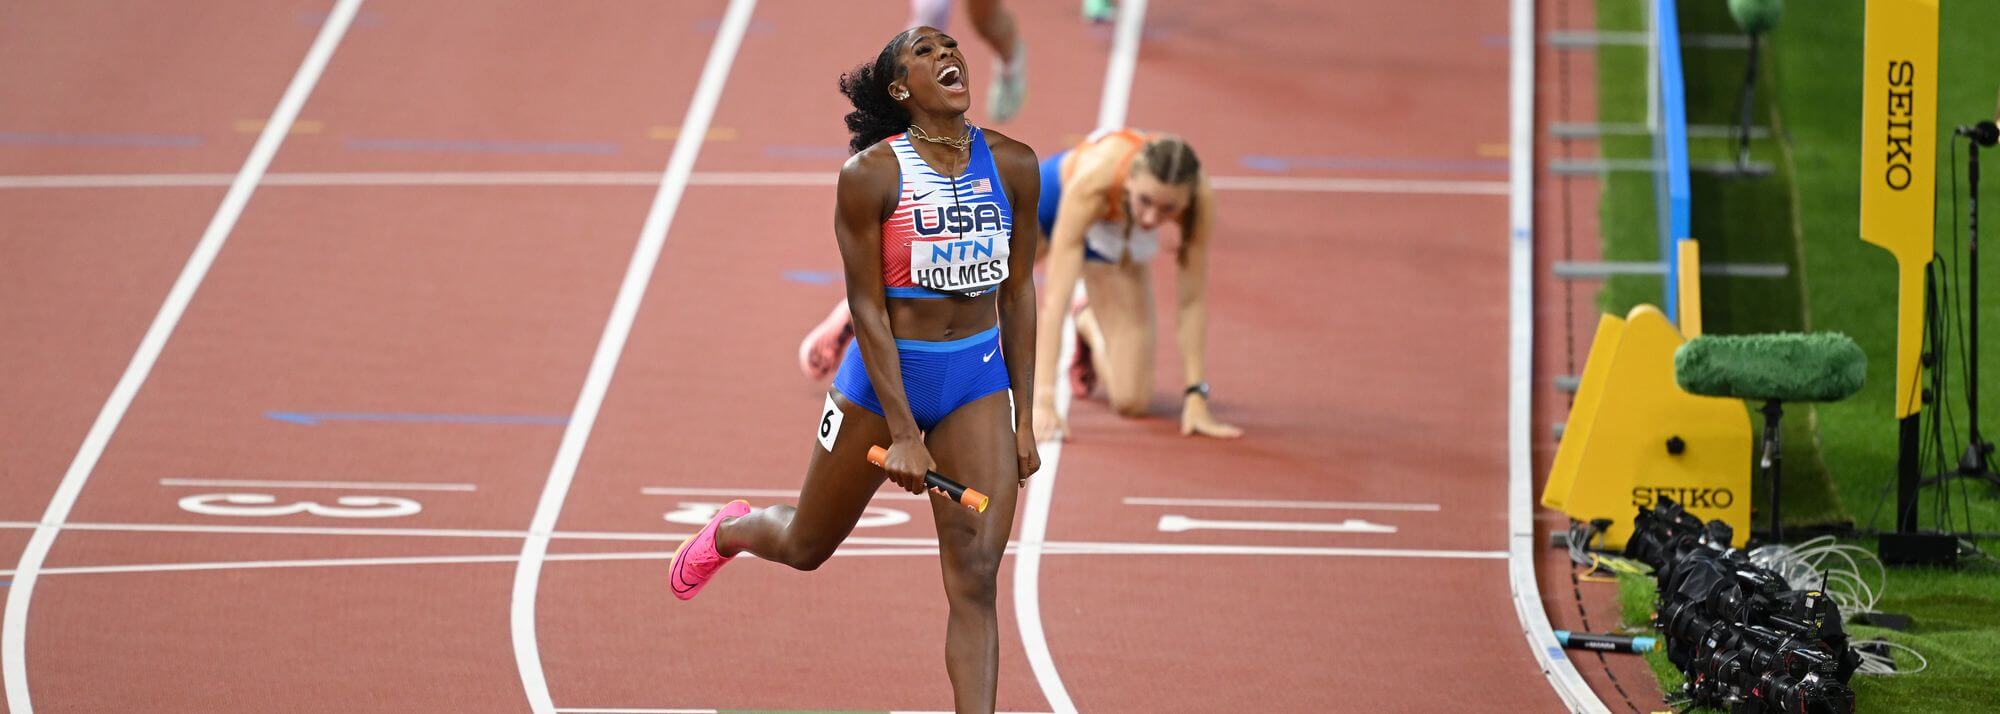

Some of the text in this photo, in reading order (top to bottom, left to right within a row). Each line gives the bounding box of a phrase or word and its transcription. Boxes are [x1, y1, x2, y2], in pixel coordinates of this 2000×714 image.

[1886, 60, 1914, 191] SEIKO
[914, 203, 1001, 235] USA
[931, 238, 994, 264] NTN
[917, 260, 1003, 288] HOLMES
[821, 410, 834, 438] 6
[178, 492, 421, 519] 3
